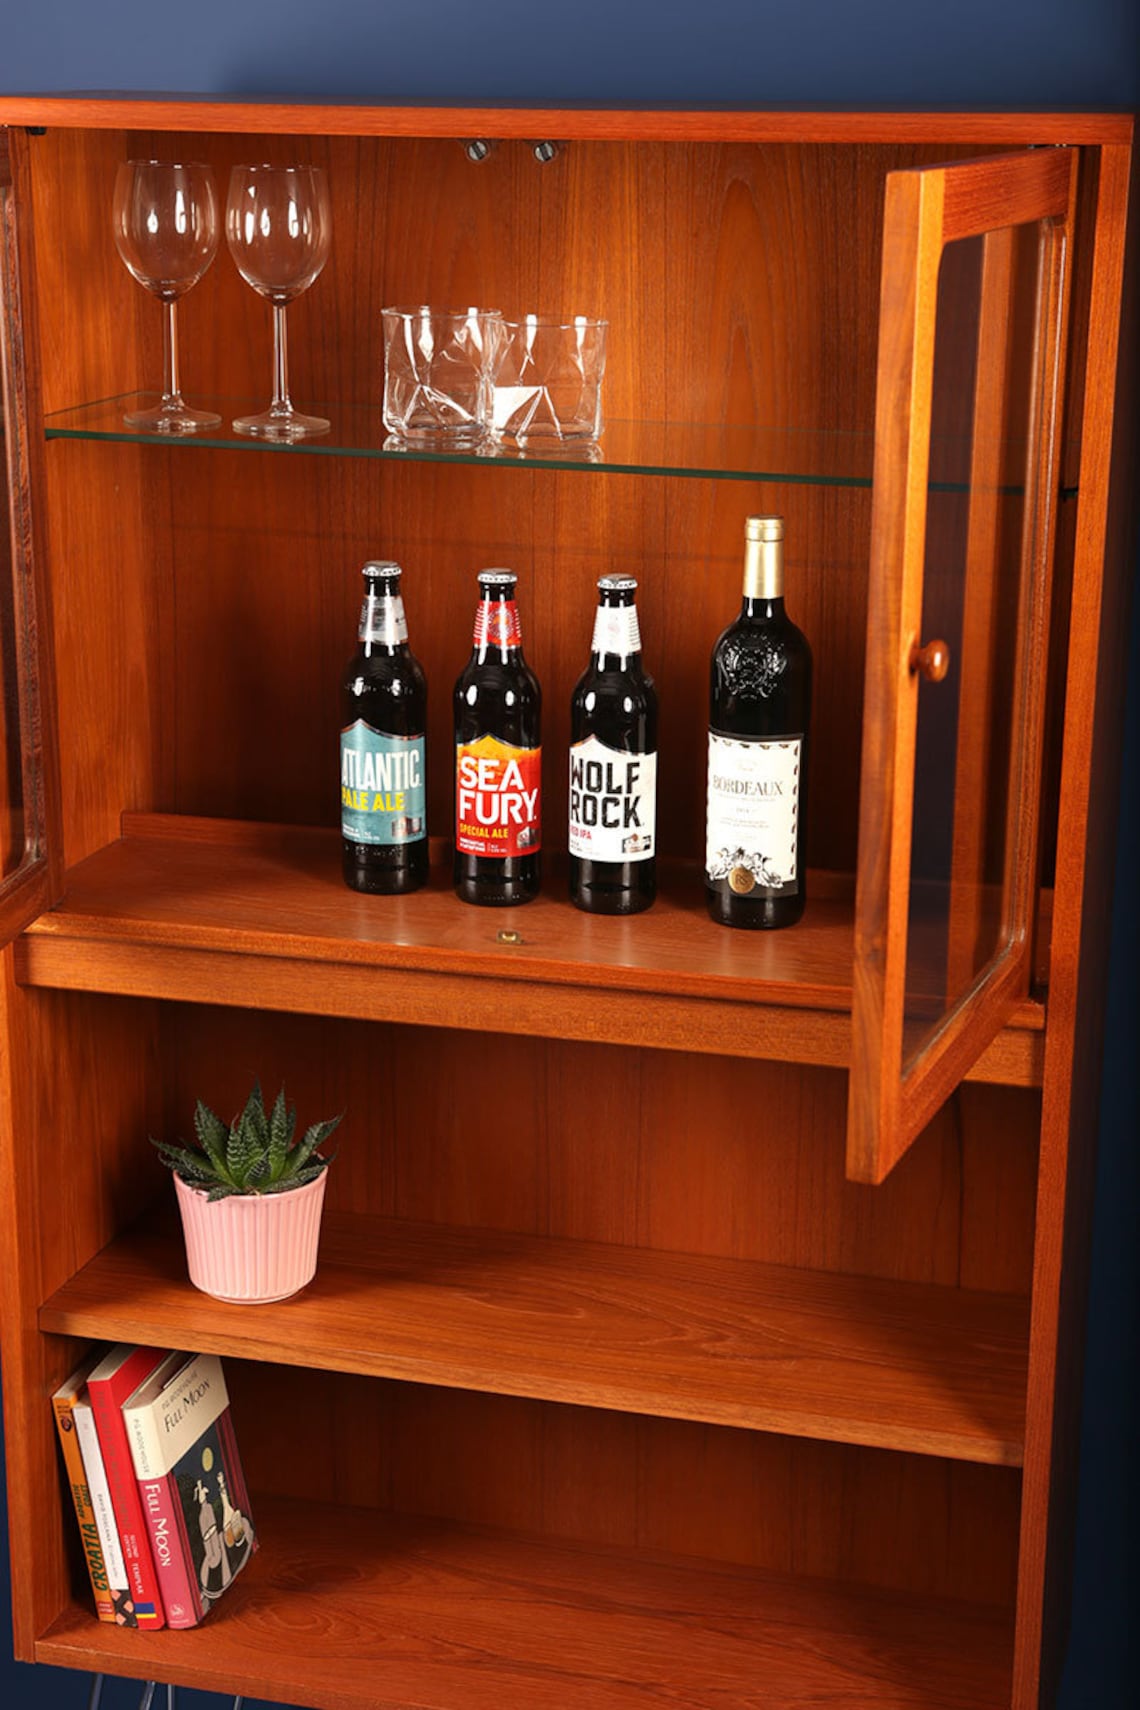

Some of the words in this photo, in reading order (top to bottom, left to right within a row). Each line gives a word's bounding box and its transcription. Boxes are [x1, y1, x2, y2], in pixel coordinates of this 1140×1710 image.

[342, 747, 420, 792] ATLANTIC
[460, 756, 525, 791] SEA
[571, 754, 640, 794] WOLF
[713, 774, 783, 796] BORDEAUX
[342, 785, 369, 811] PALE
[372, 791, 405, 812] ALE
[571, 789, 641, 828] ROCK
[460, 822, 490, 839] SPECIAL
[491, 828, 509, 839] ALE
[82, 1523, 107, 1591] CROATIA
[131, 1562, 144, 1595] TEMPLAR
